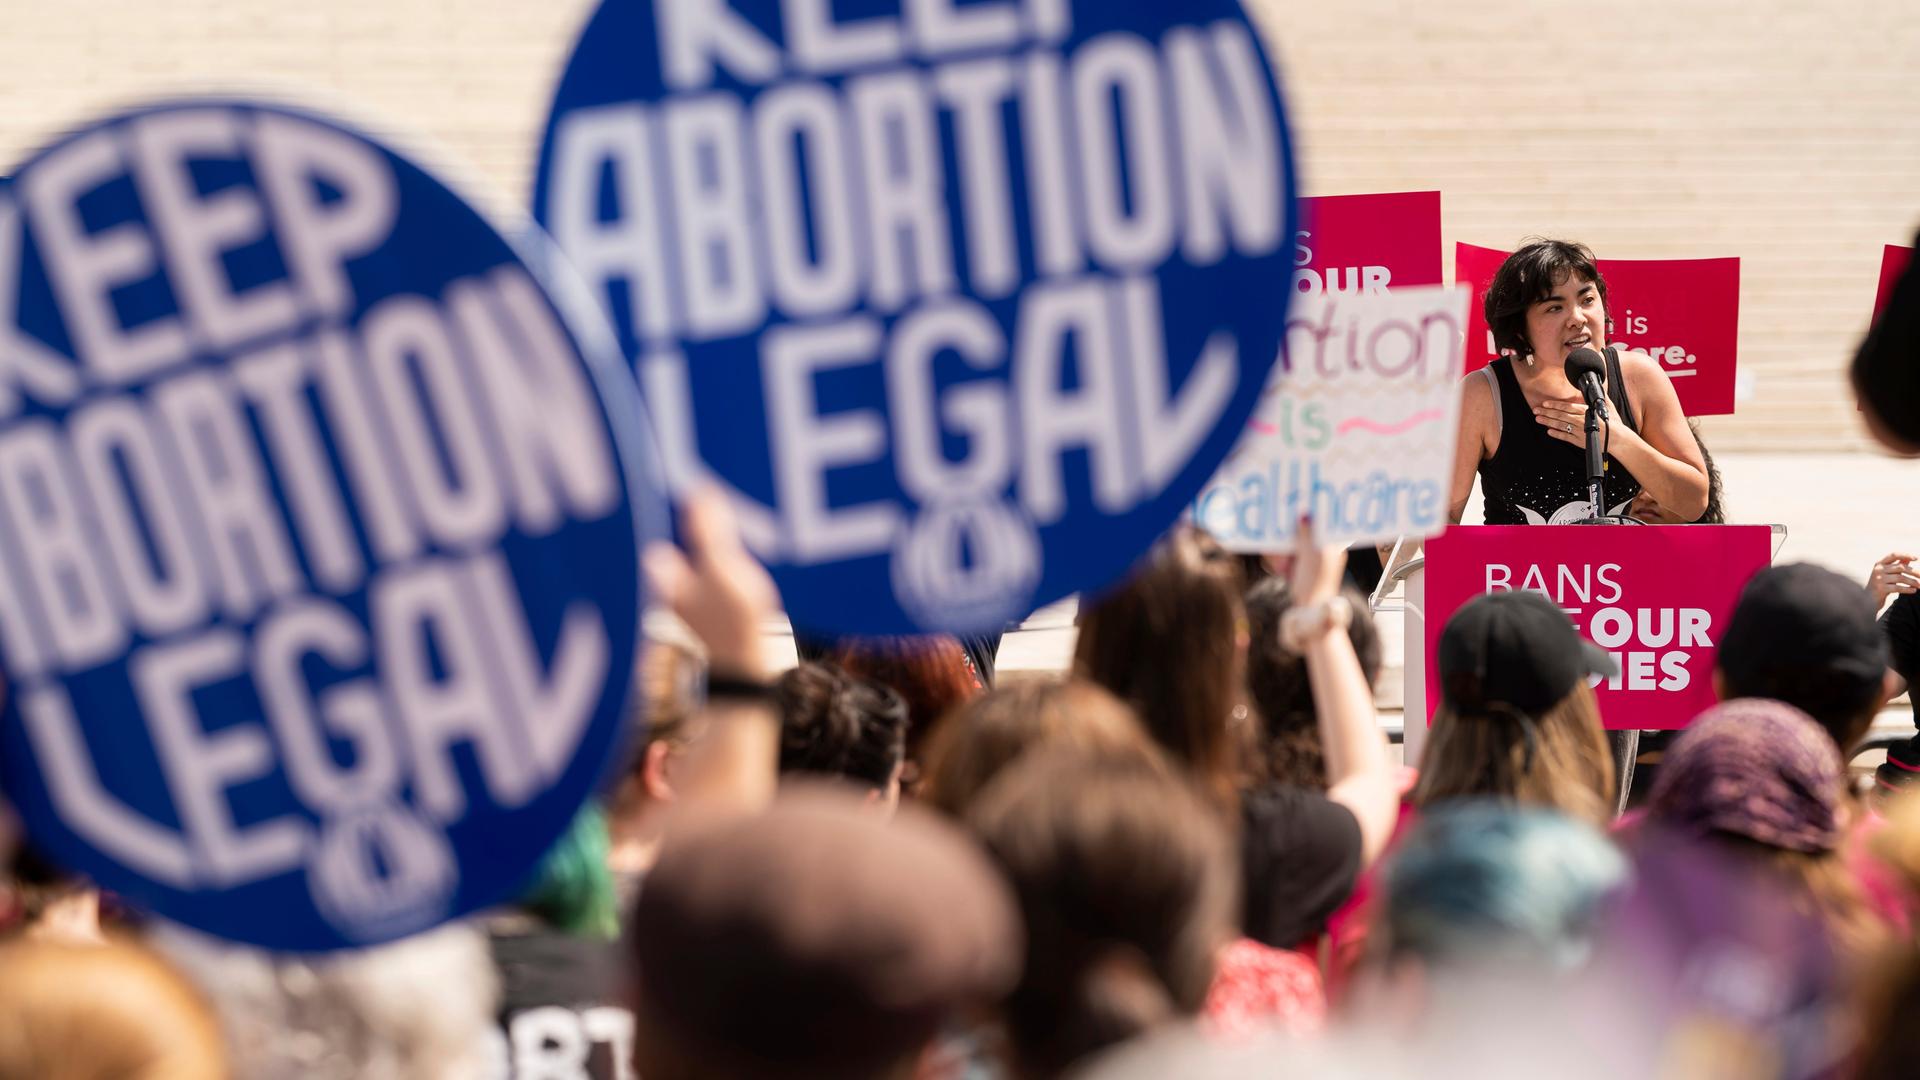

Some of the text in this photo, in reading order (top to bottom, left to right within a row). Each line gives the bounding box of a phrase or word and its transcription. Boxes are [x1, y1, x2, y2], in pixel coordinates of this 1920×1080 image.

[547, 18, 1286, 343] ABORTION
[1293, 266, 1392, 297] OUR
[1280, 302, 1461, 380] rtion
[1626, 309, 1649, 335] is
[637, 274, 1241, 567] LEGAL
[1192, 458, 1441, 541] ealthcare
[1485, 563, 1623, 604] BANS
[1590, 607, 1714, 648] OUR
[1588, 651, 1691, 691] IES
[17, 553, 609, 890] LEGAL
